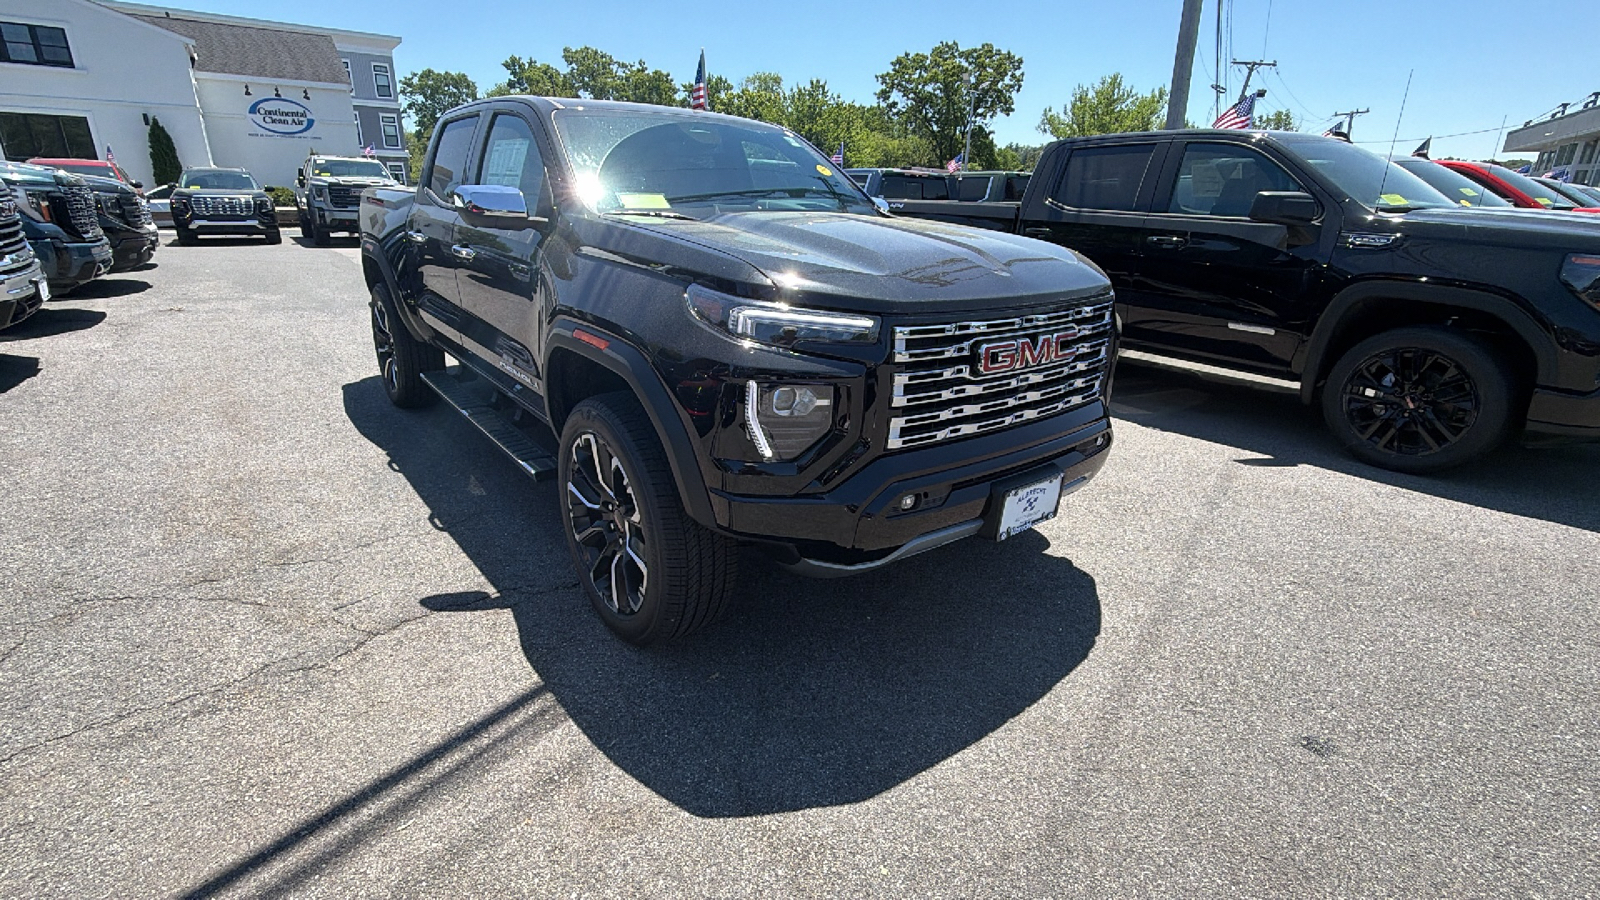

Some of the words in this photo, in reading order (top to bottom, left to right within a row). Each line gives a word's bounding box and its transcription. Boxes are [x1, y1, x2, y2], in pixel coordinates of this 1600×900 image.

[257, 107, 307, 118] Continental
[263, 116, 289, 125] Clean
[290, 118, 305, 126] Air
[979, 332, 1078, 374] GMC
